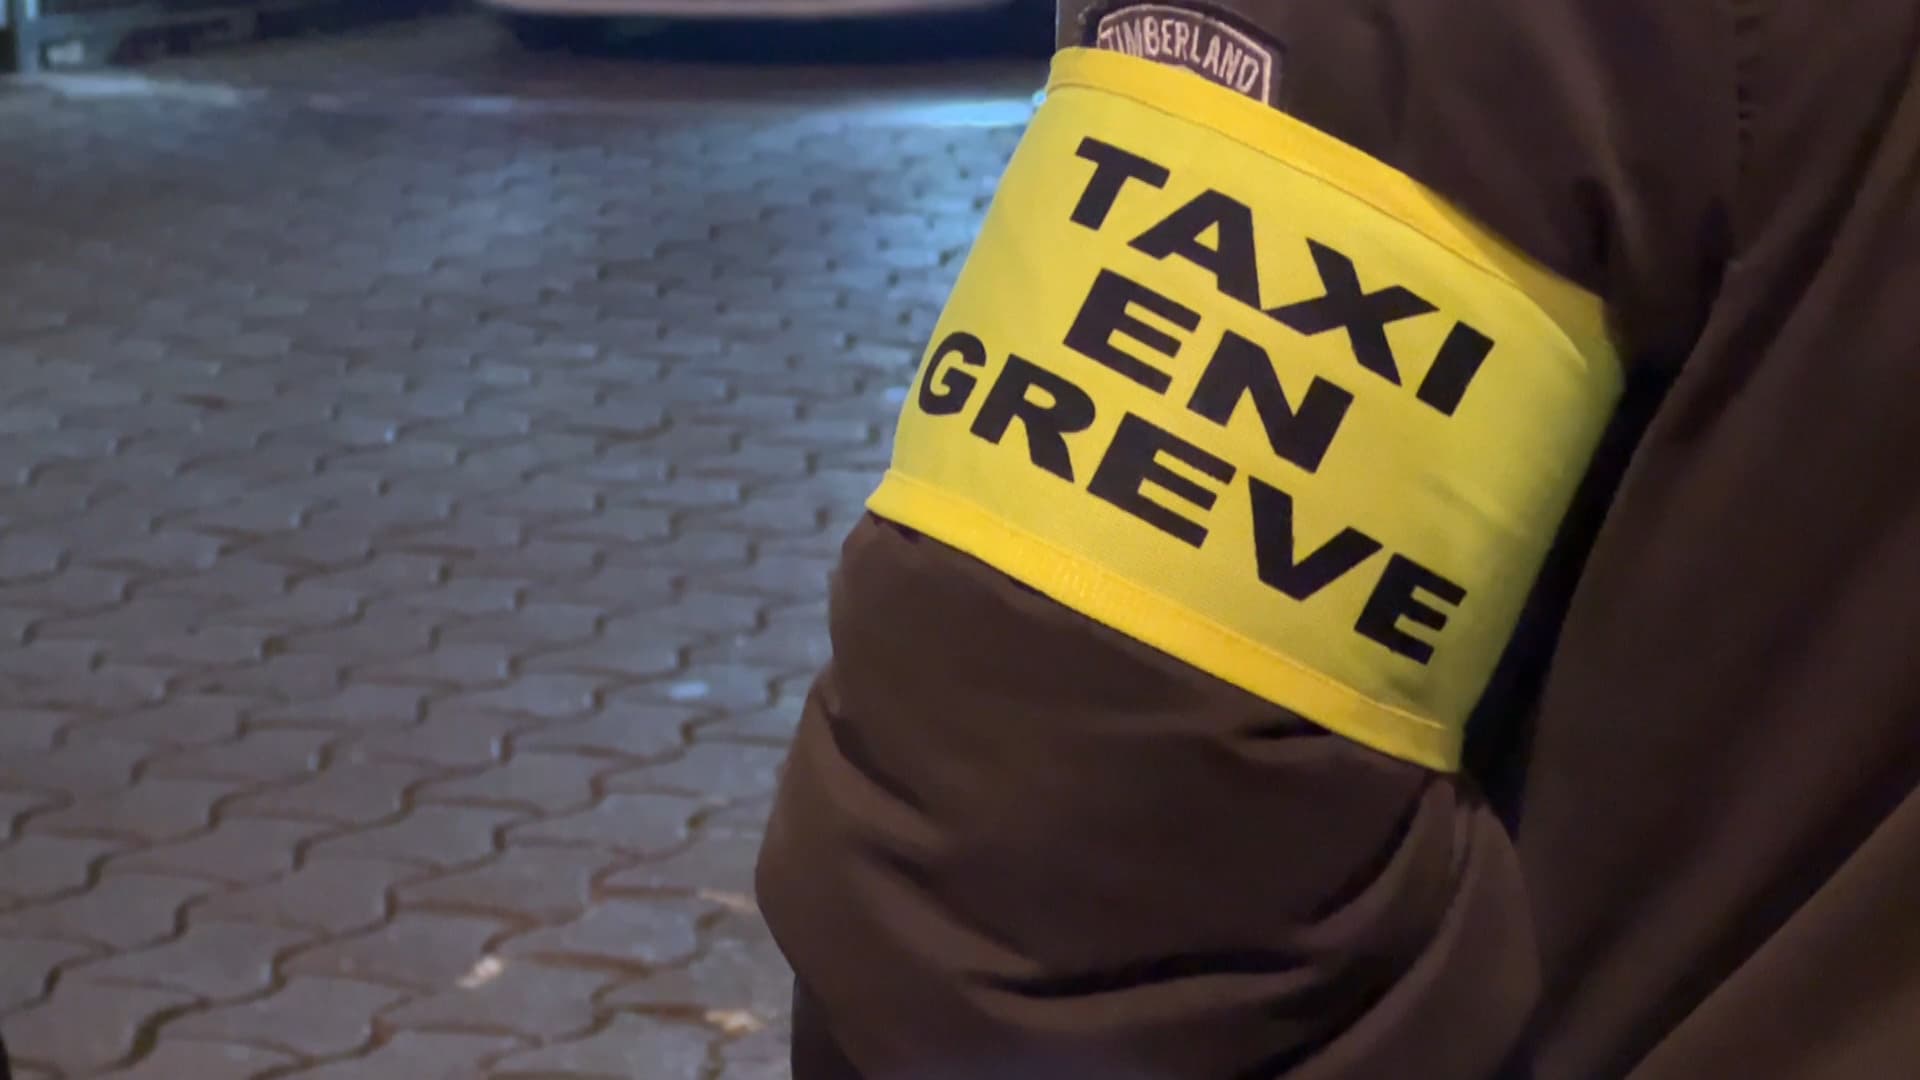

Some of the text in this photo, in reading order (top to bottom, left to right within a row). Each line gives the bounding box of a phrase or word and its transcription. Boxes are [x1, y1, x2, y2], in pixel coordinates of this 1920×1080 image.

[1099, 16, 1259, 93] TIMBERLAND
[1063, 268, 1354, 473] EN
[1070, 136, 1495, 417] TAXI
[918, 331, 1468, 665] GREVE
